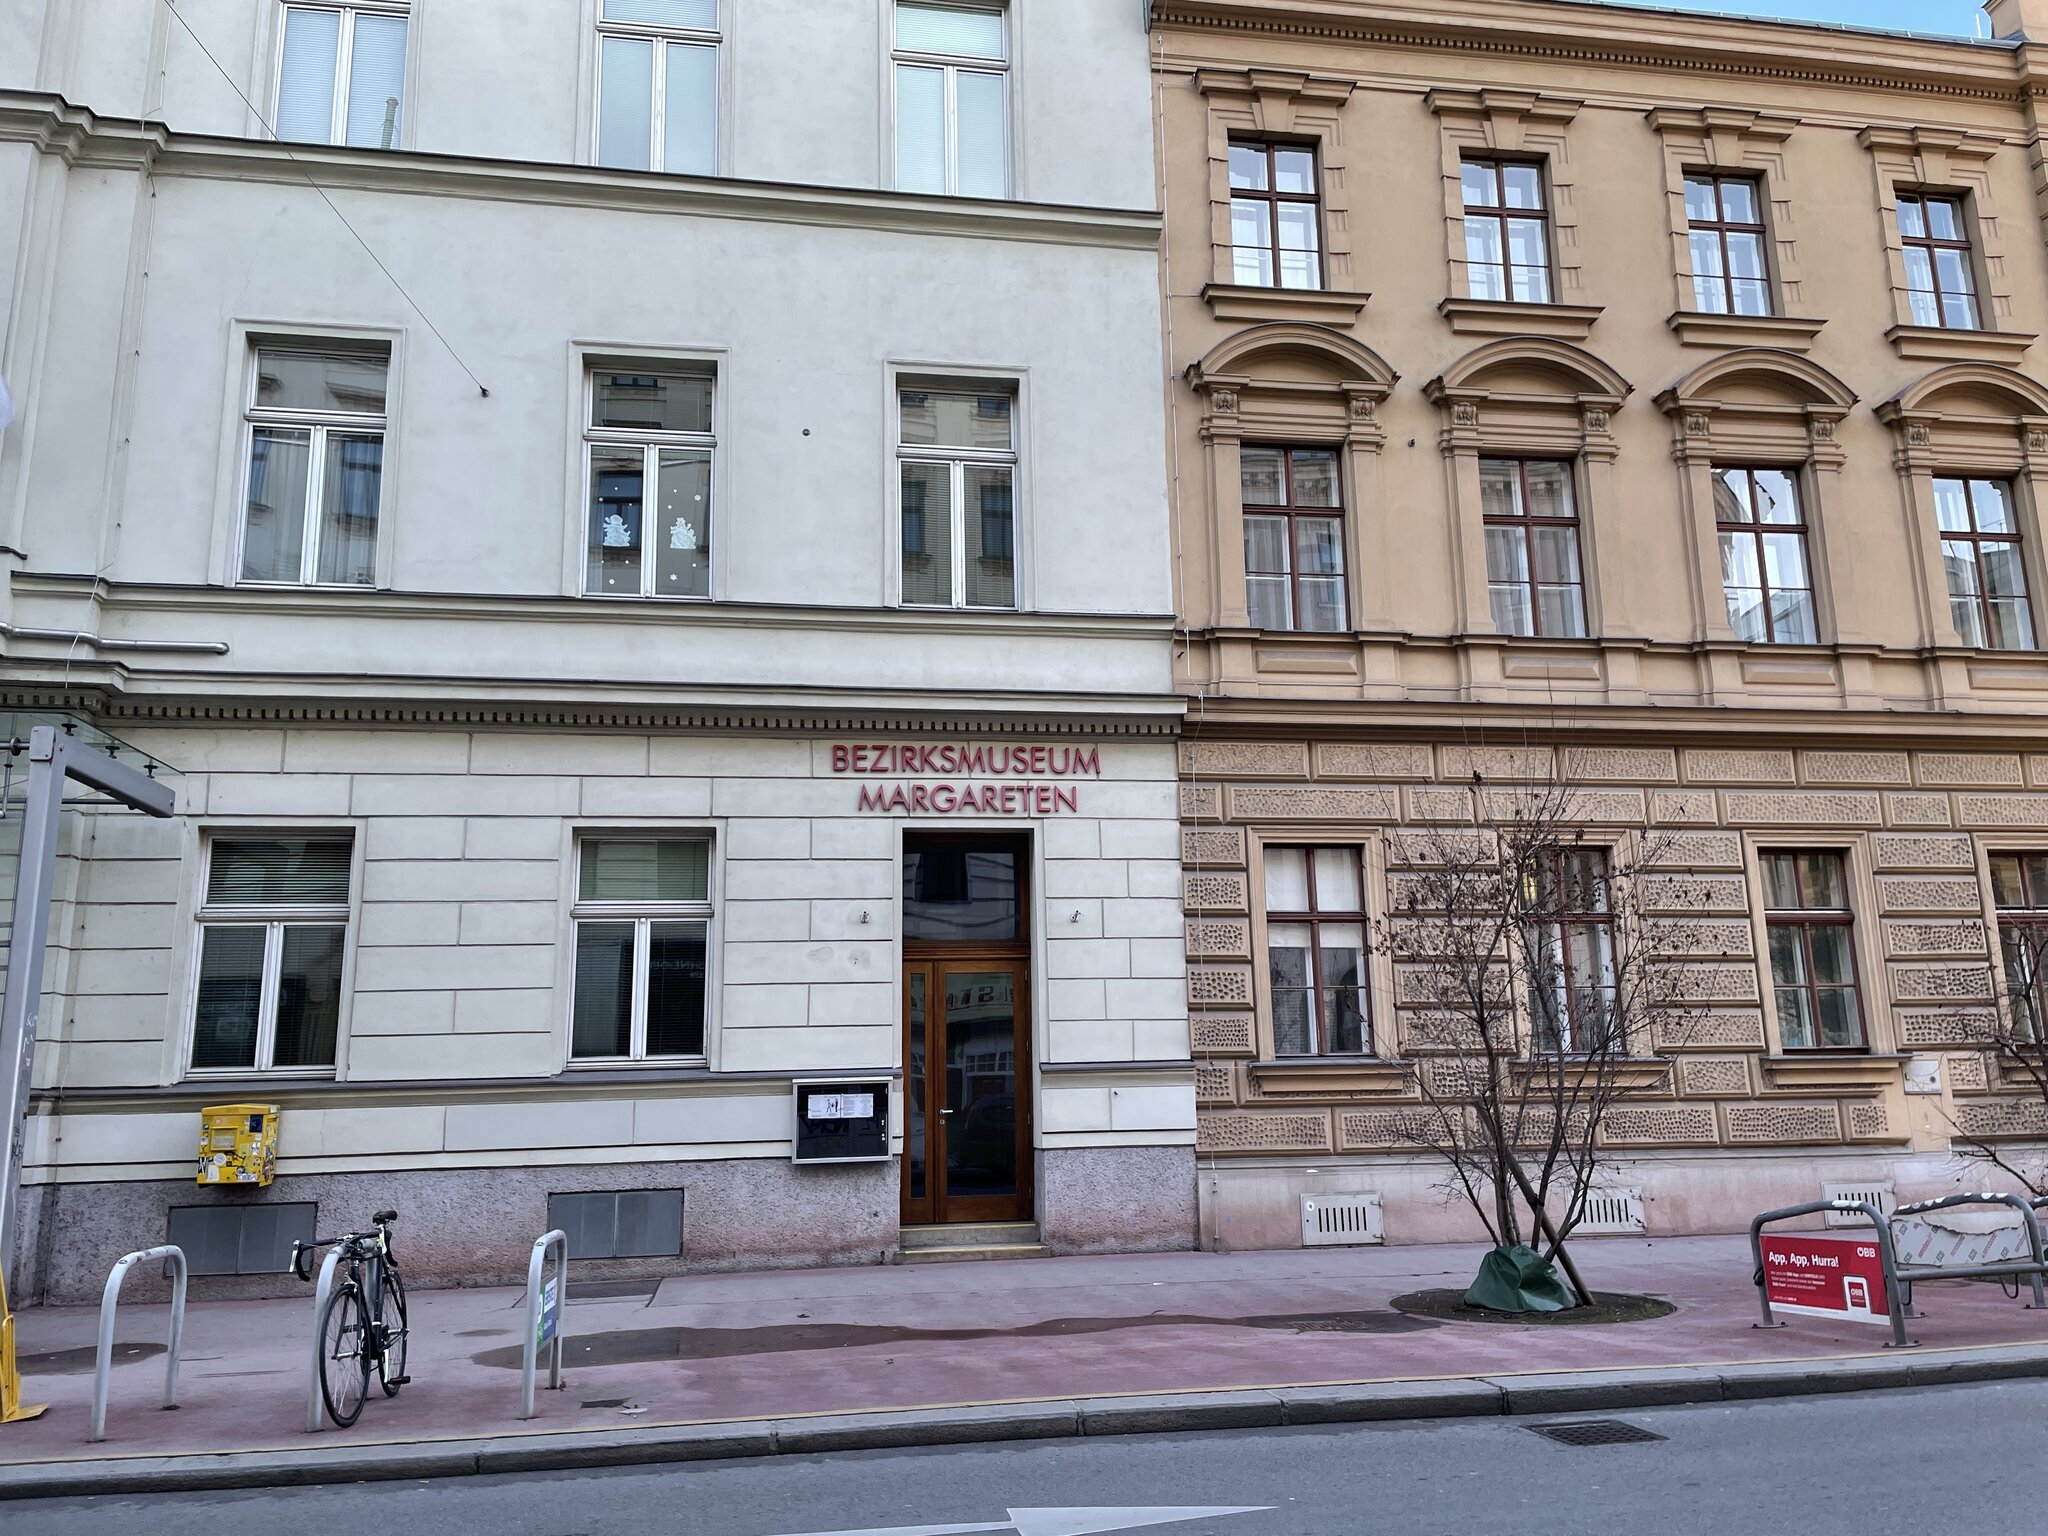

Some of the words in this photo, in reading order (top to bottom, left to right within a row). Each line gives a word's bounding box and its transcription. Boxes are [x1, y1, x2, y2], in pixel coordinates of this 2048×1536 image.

[832, 744, 1101, 774] BEZIRKSMUSEUM
[858, 783, 1078, 813] MARGARETEN
[1769, 1251, 1788, 1266] App,
[1790, 1253, 1810, 1268] App,
[1811, 1254, 1839, 1268] Hurra!
